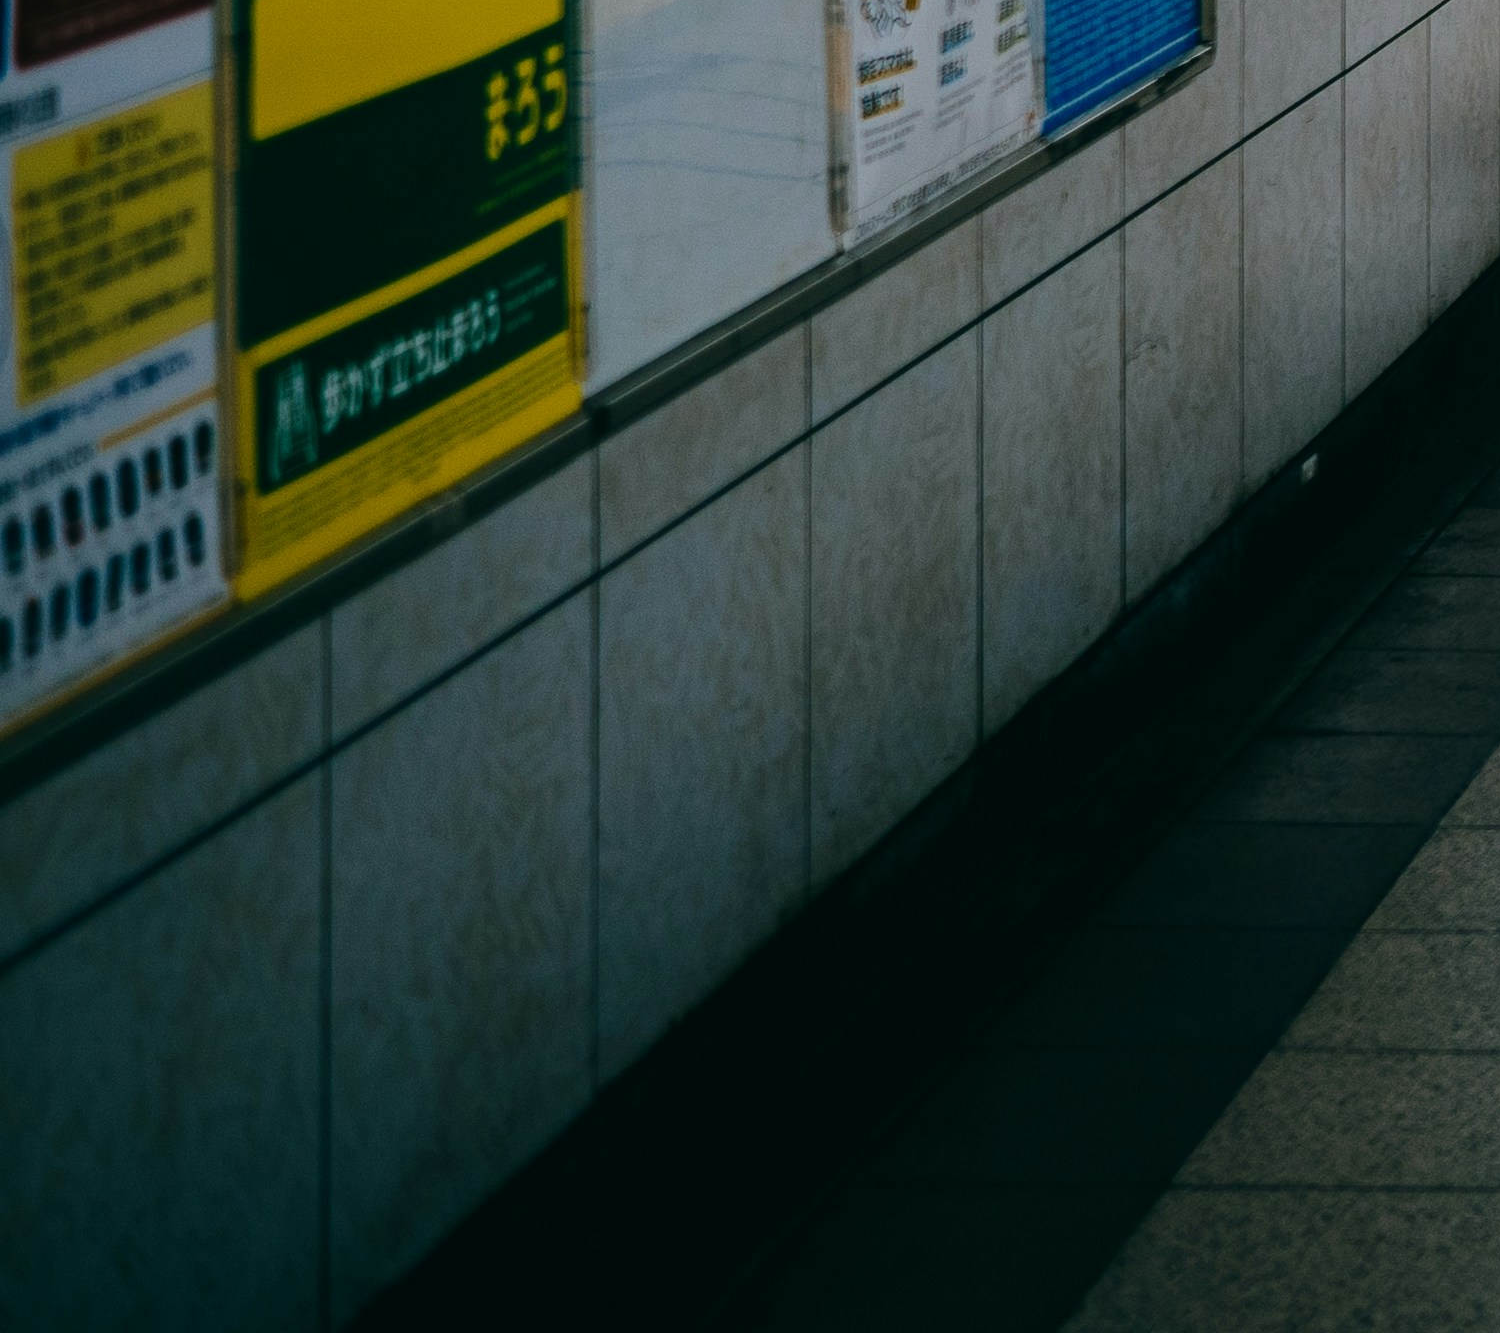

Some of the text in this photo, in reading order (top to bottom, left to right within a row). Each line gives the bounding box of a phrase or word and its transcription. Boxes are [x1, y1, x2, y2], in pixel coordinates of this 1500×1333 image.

[484, 43, 566, 161] まろう
[322, 288, 501, 431] 歩かず立ち止まろう
